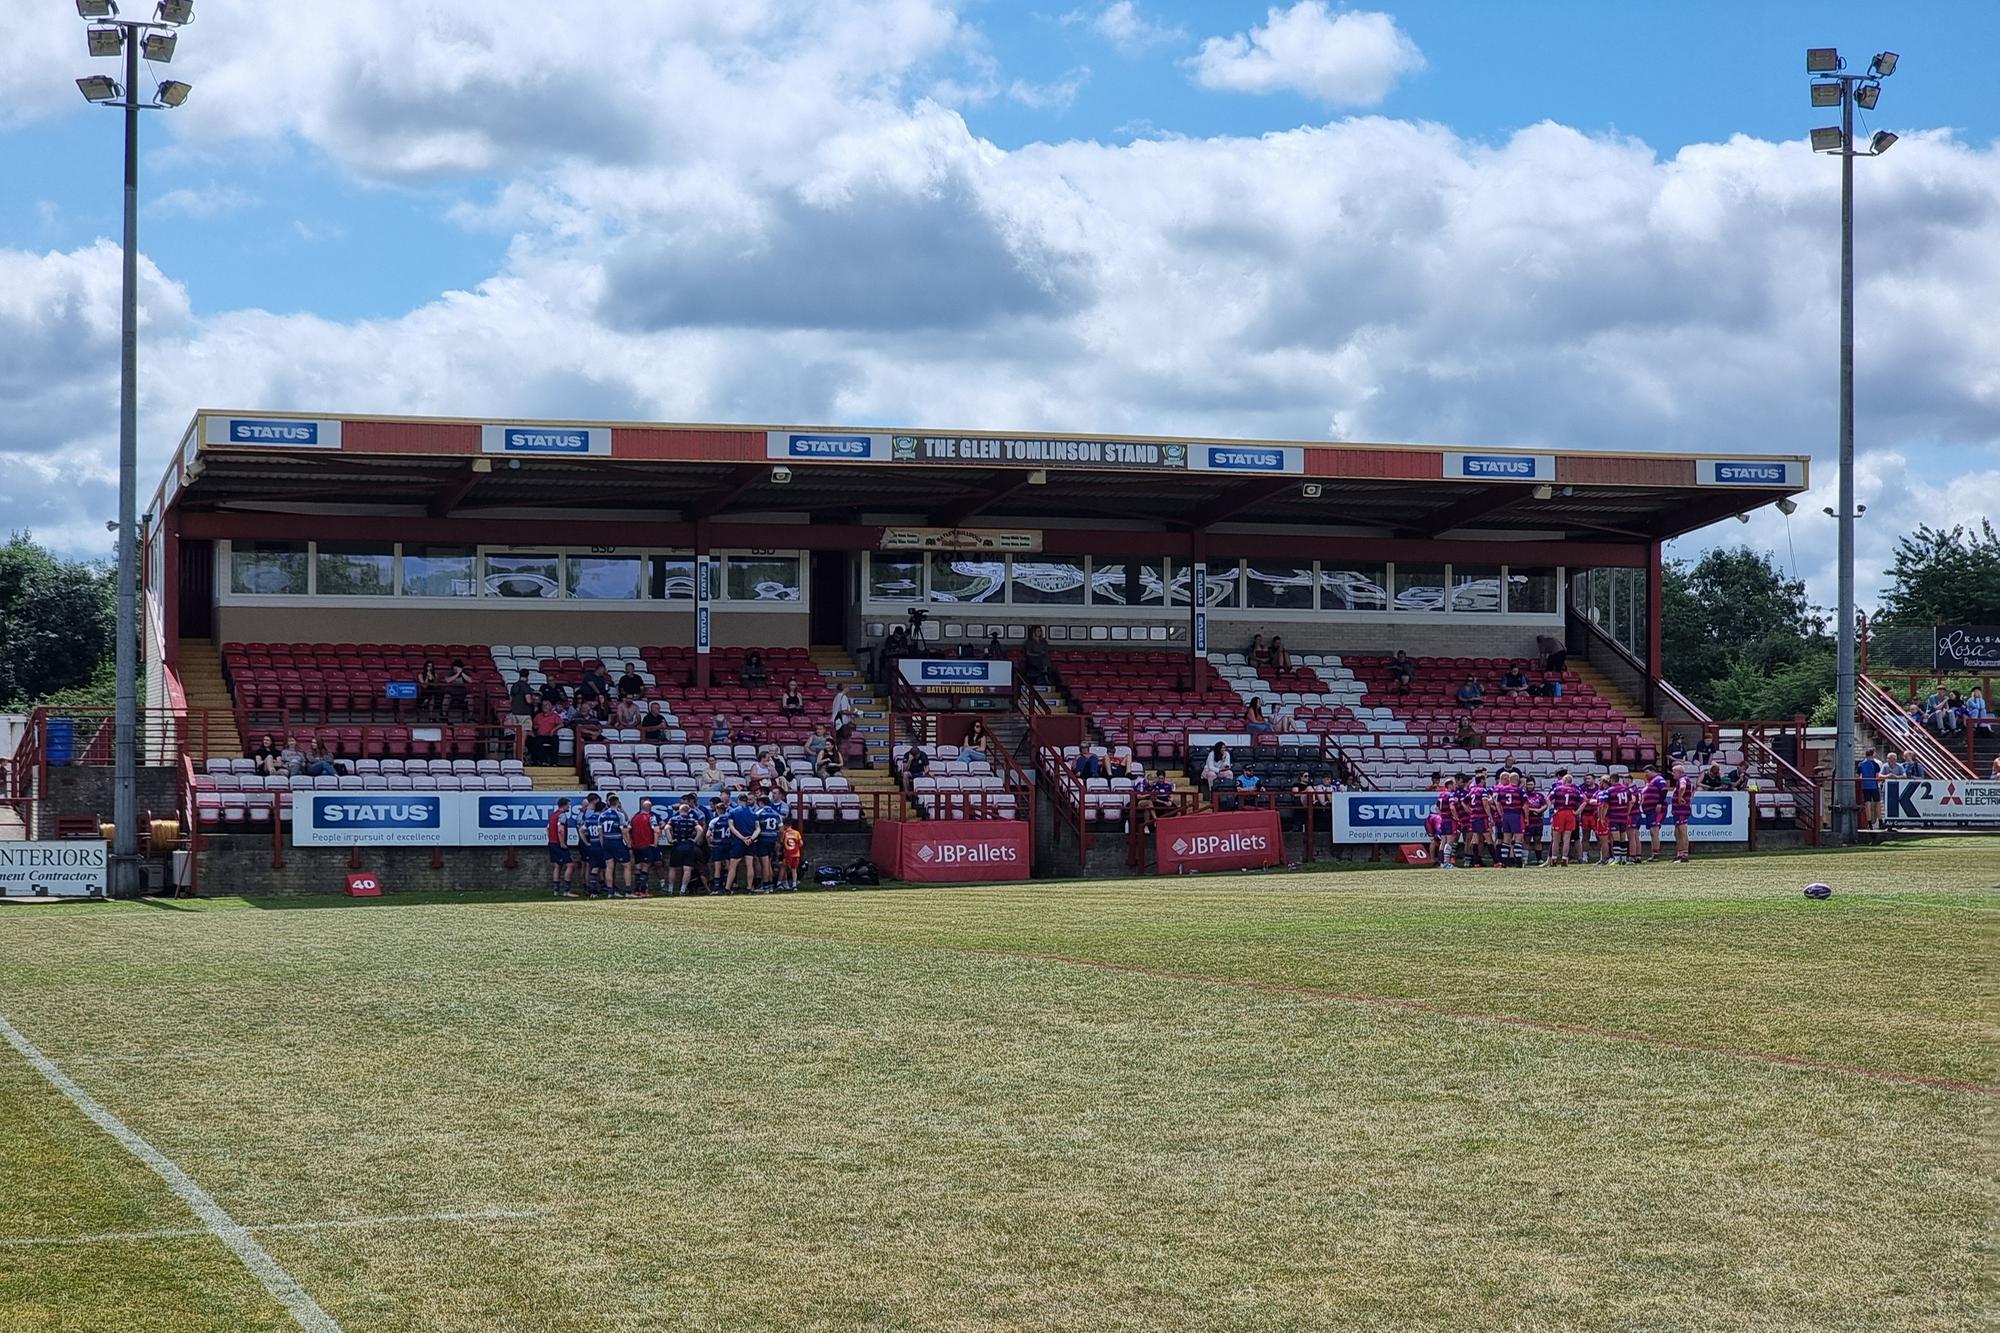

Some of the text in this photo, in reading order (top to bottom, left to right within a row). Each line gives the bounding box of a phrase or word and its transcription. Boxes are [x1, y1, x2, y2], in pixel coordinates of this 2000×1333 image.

[237, 426, 310, 440] STATUS
[511, 434, 582, 447] STATUS
[795, 440, 864, 453] STATUS
[924, 438, 1158, 463] THE GLEN TOMLINSON STAND
[1214, 452, 1278, 466] STATUS
[1468, 460, 1530, 473] STATUS
[1720, 467, 1781, 479] STATUS
[1939, 630, 1984, 660] Rosa
[927, 665, 983, 676] STATUS
[1505, 793, 1512, 805] 3
[1564, 793, 1569, 805] 1
[1616, 791, 1628, 805] 14
[323, 804, 429, 822] STATUS
[602, 820, 614, 833] 17
[765, 818, 777, 830] 13
[312, 832, 441, 842] People in pursuit of excellence
[478, 832, 547, 842] People in pursuit
[1349, 831, 1373, 840] People
[1383, 831, 1409, 840] pursuit
[1696, 829, 1733, 837] excellence
[1188, 833, 1266, 856] JBPallets
[934, 843, 1017, 863] JBPallets
[28, 870, 99, 881] Contractors
[352, 880, 376, 890] 40
